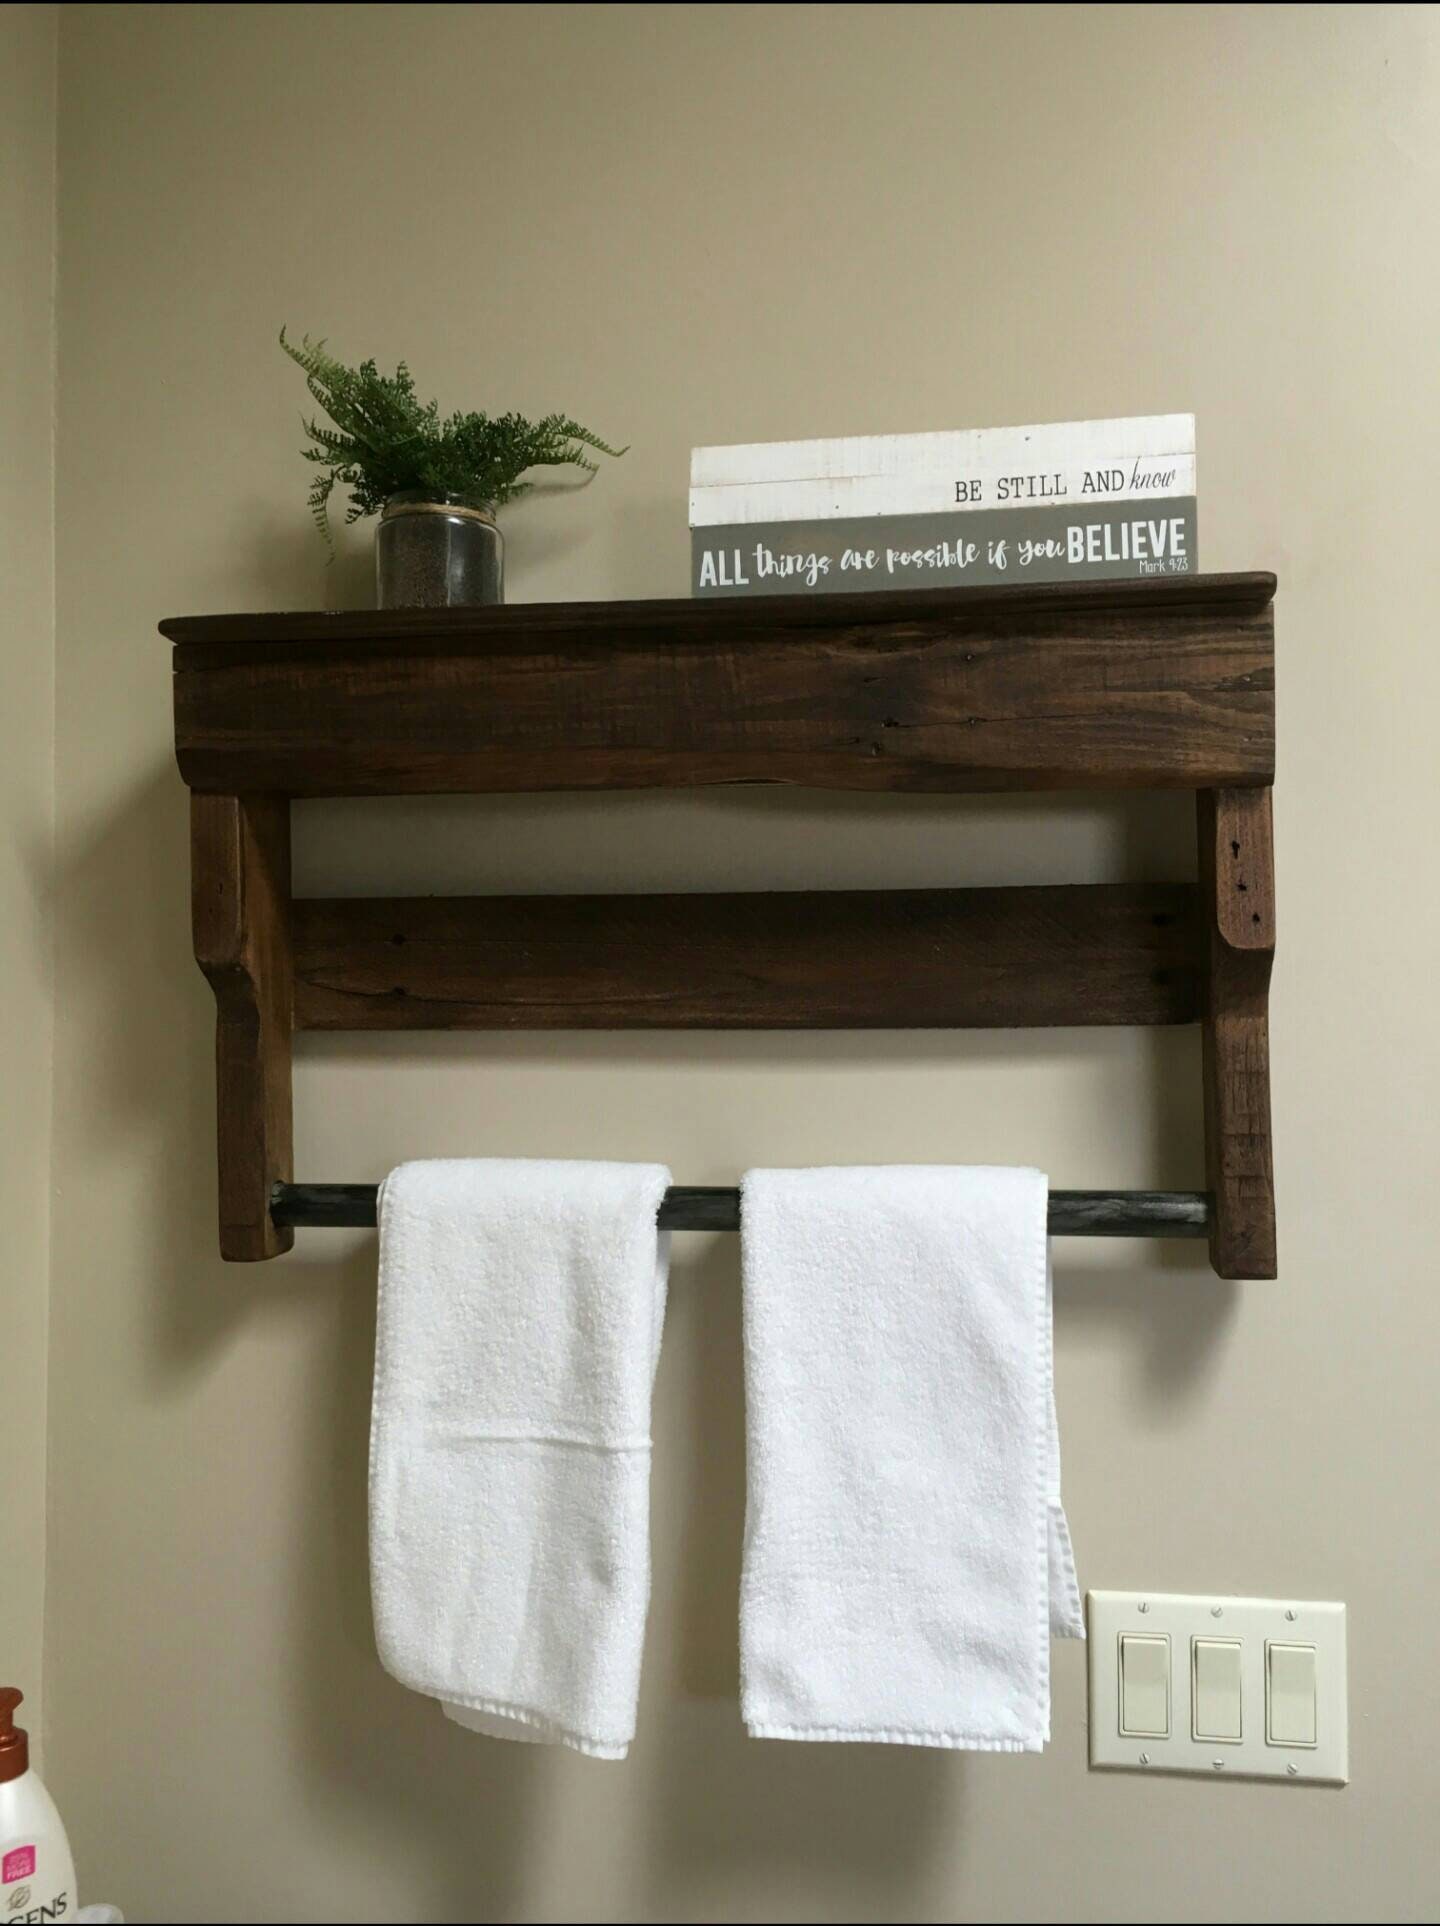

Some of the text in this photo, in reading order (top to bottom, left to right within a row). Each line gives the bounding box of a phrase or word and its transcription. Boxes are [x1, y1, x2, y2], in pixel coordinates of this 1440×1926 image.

[955, 456, 1177, 502] BE STILL AND know
[699, 518, 1186, 587] ALL things are possible if you BELIEVE
[1139, 559, 1166, 574] Mark
